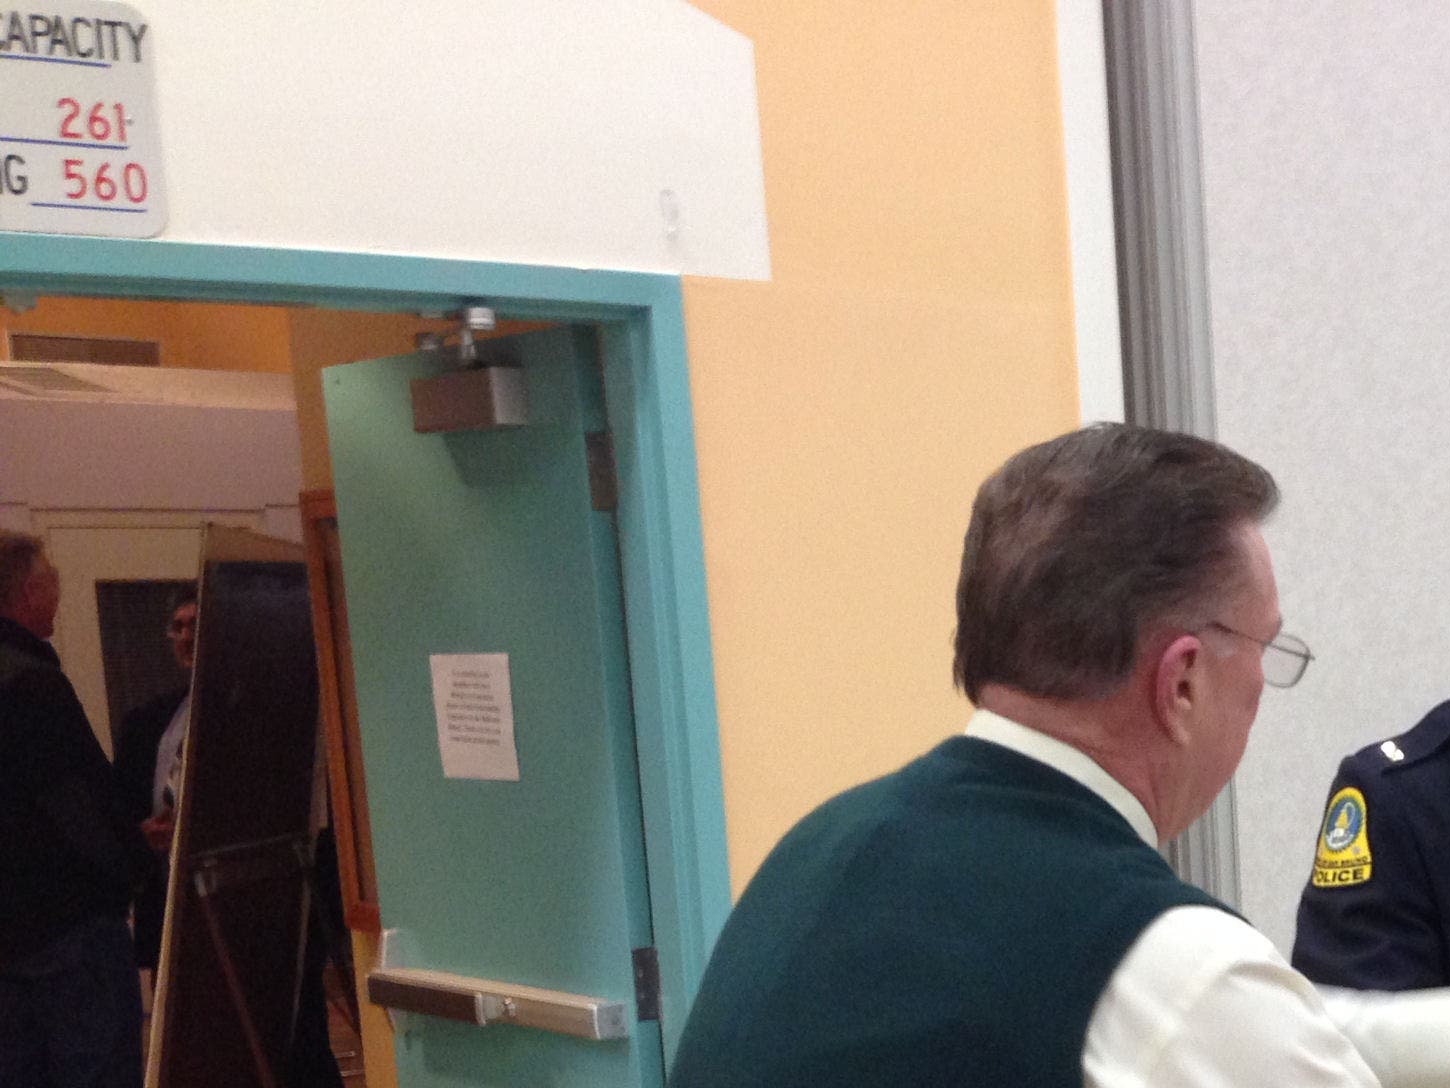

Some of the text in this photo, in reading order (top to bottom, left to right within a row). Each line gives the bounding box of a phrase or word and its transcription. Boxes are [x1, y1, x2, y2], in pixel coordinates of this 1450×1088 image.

[0, 10, 148, 63] APACITY
[57, 97, 128, 142] 261
[63, 158, 148, 203] 560
